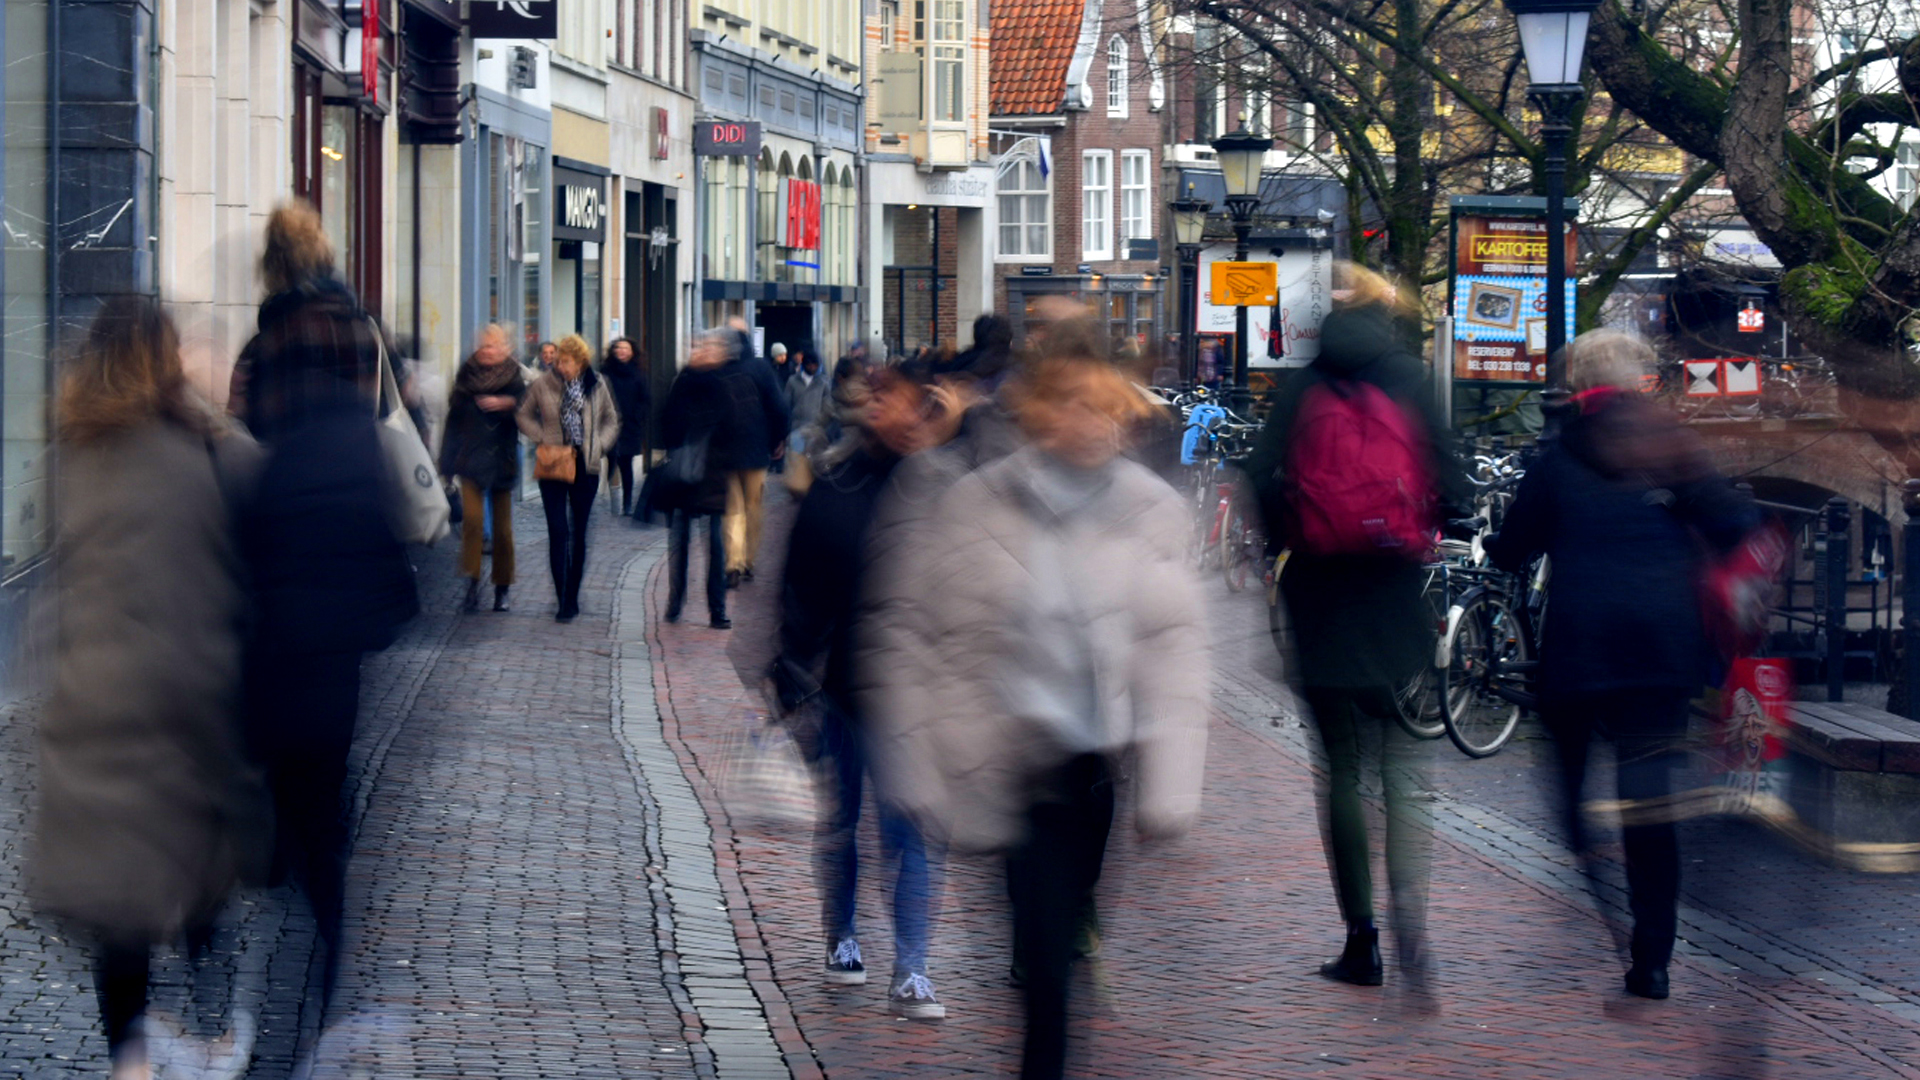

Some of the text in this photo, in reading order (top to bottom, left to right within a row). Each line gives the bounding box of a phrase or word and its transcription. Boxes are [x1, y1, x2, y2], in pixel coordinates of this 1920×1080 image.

[713, 124, 746, 143] DIDI
[565, 185, 598, 229] MANGO
[787, 178, 821, 250] HEMA
[1477, 241, 1548, 258] KARTOFFE
